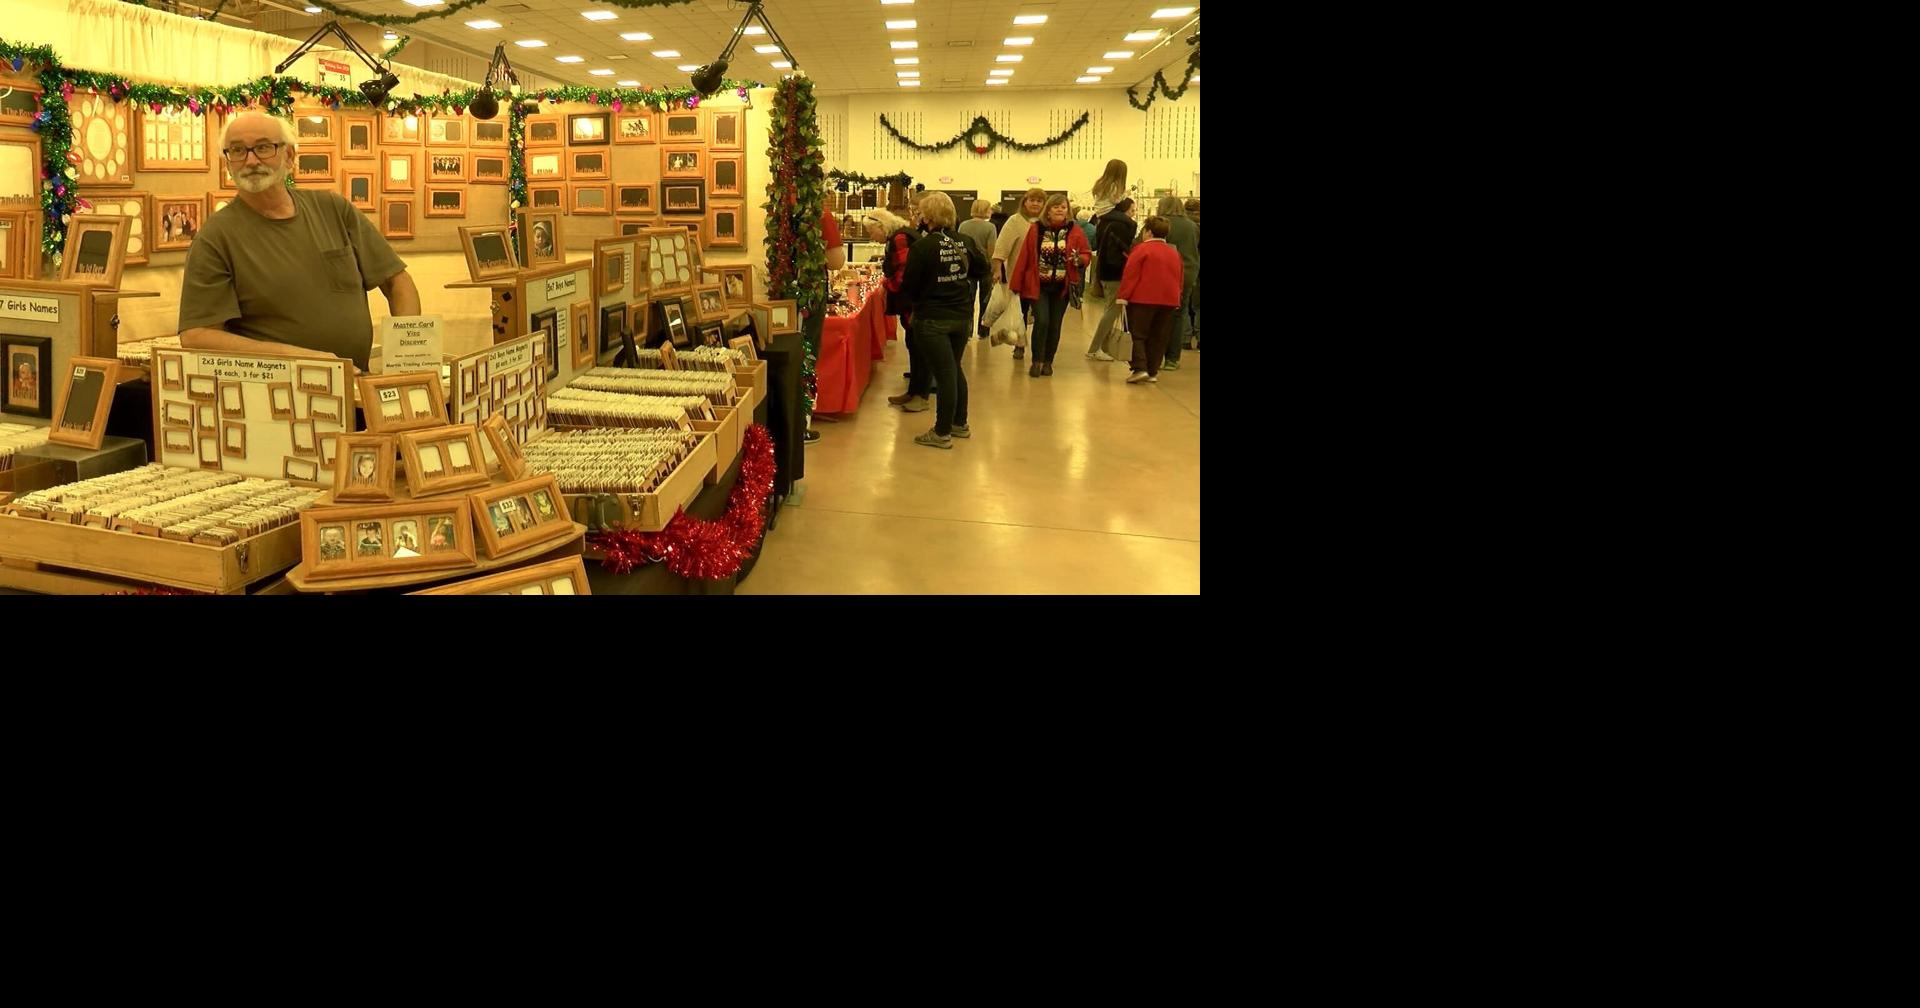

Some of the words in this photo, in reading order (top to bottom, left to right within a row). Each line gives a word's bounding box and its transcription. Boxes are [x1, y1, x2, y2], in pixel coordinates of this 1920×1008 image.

[8, 300, 27, 311] Girls
[30, 302, 58, 314] Names
[217, 358, 233, 367] Girls
[235, 360, 254, 368] Name
[257, 361, 286, 371] Magnets
[224, 370, 240, 378] each,
[383, 390, 397, 399] $23
